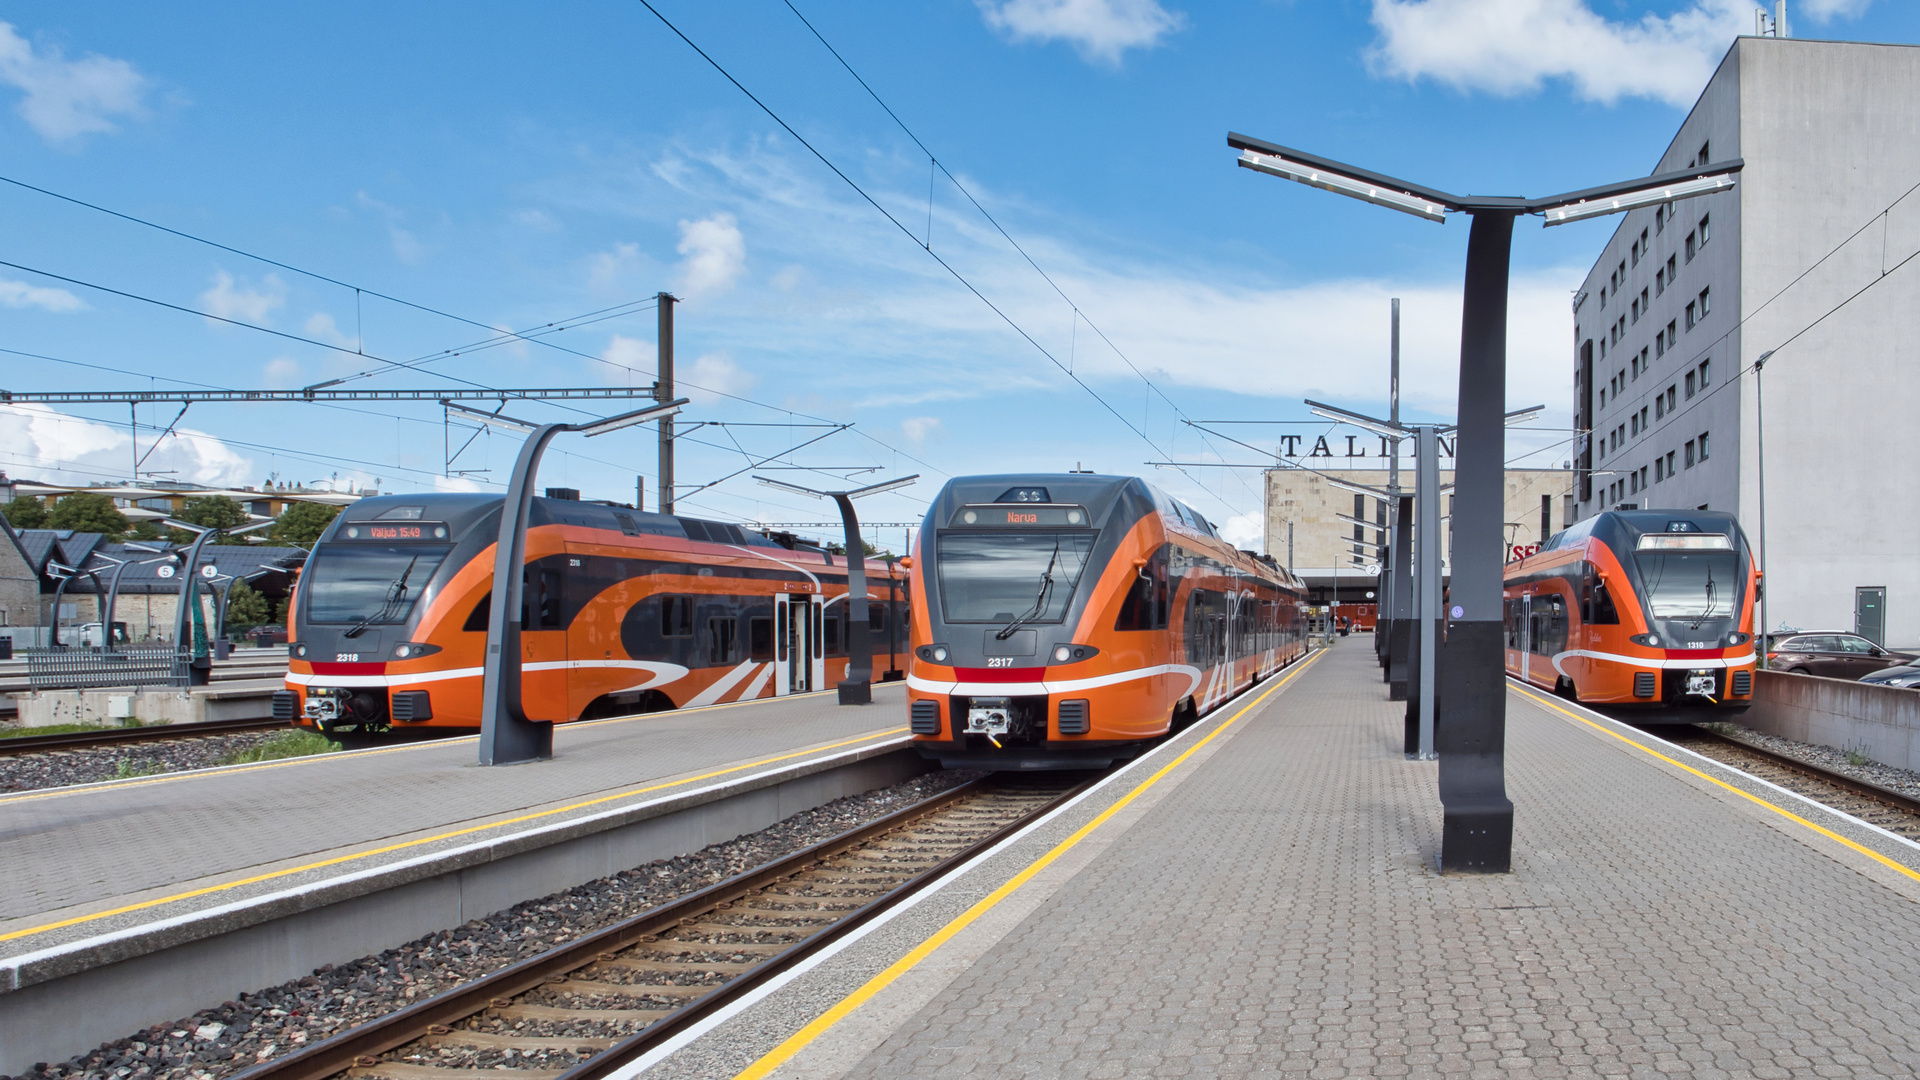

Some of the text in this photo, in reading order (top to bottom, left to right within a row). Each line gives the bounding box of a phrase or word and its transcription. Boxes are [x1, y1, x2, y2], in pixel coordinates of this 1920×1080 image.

[1007, 511, 1037, 523] Narva
[371, 527, 420, 538] Väljub 15:49
[1512, 545, 1540, 561] SE
[163, 567, 169, 577] 5
[206, 567, 212, 576] 4
[1370, 565, 1376, 575] 2
[1687, 641, 1704, 649] 1310
[336, 653, 359, 662] 2318
[987, 657, 1014, 667] 2317
